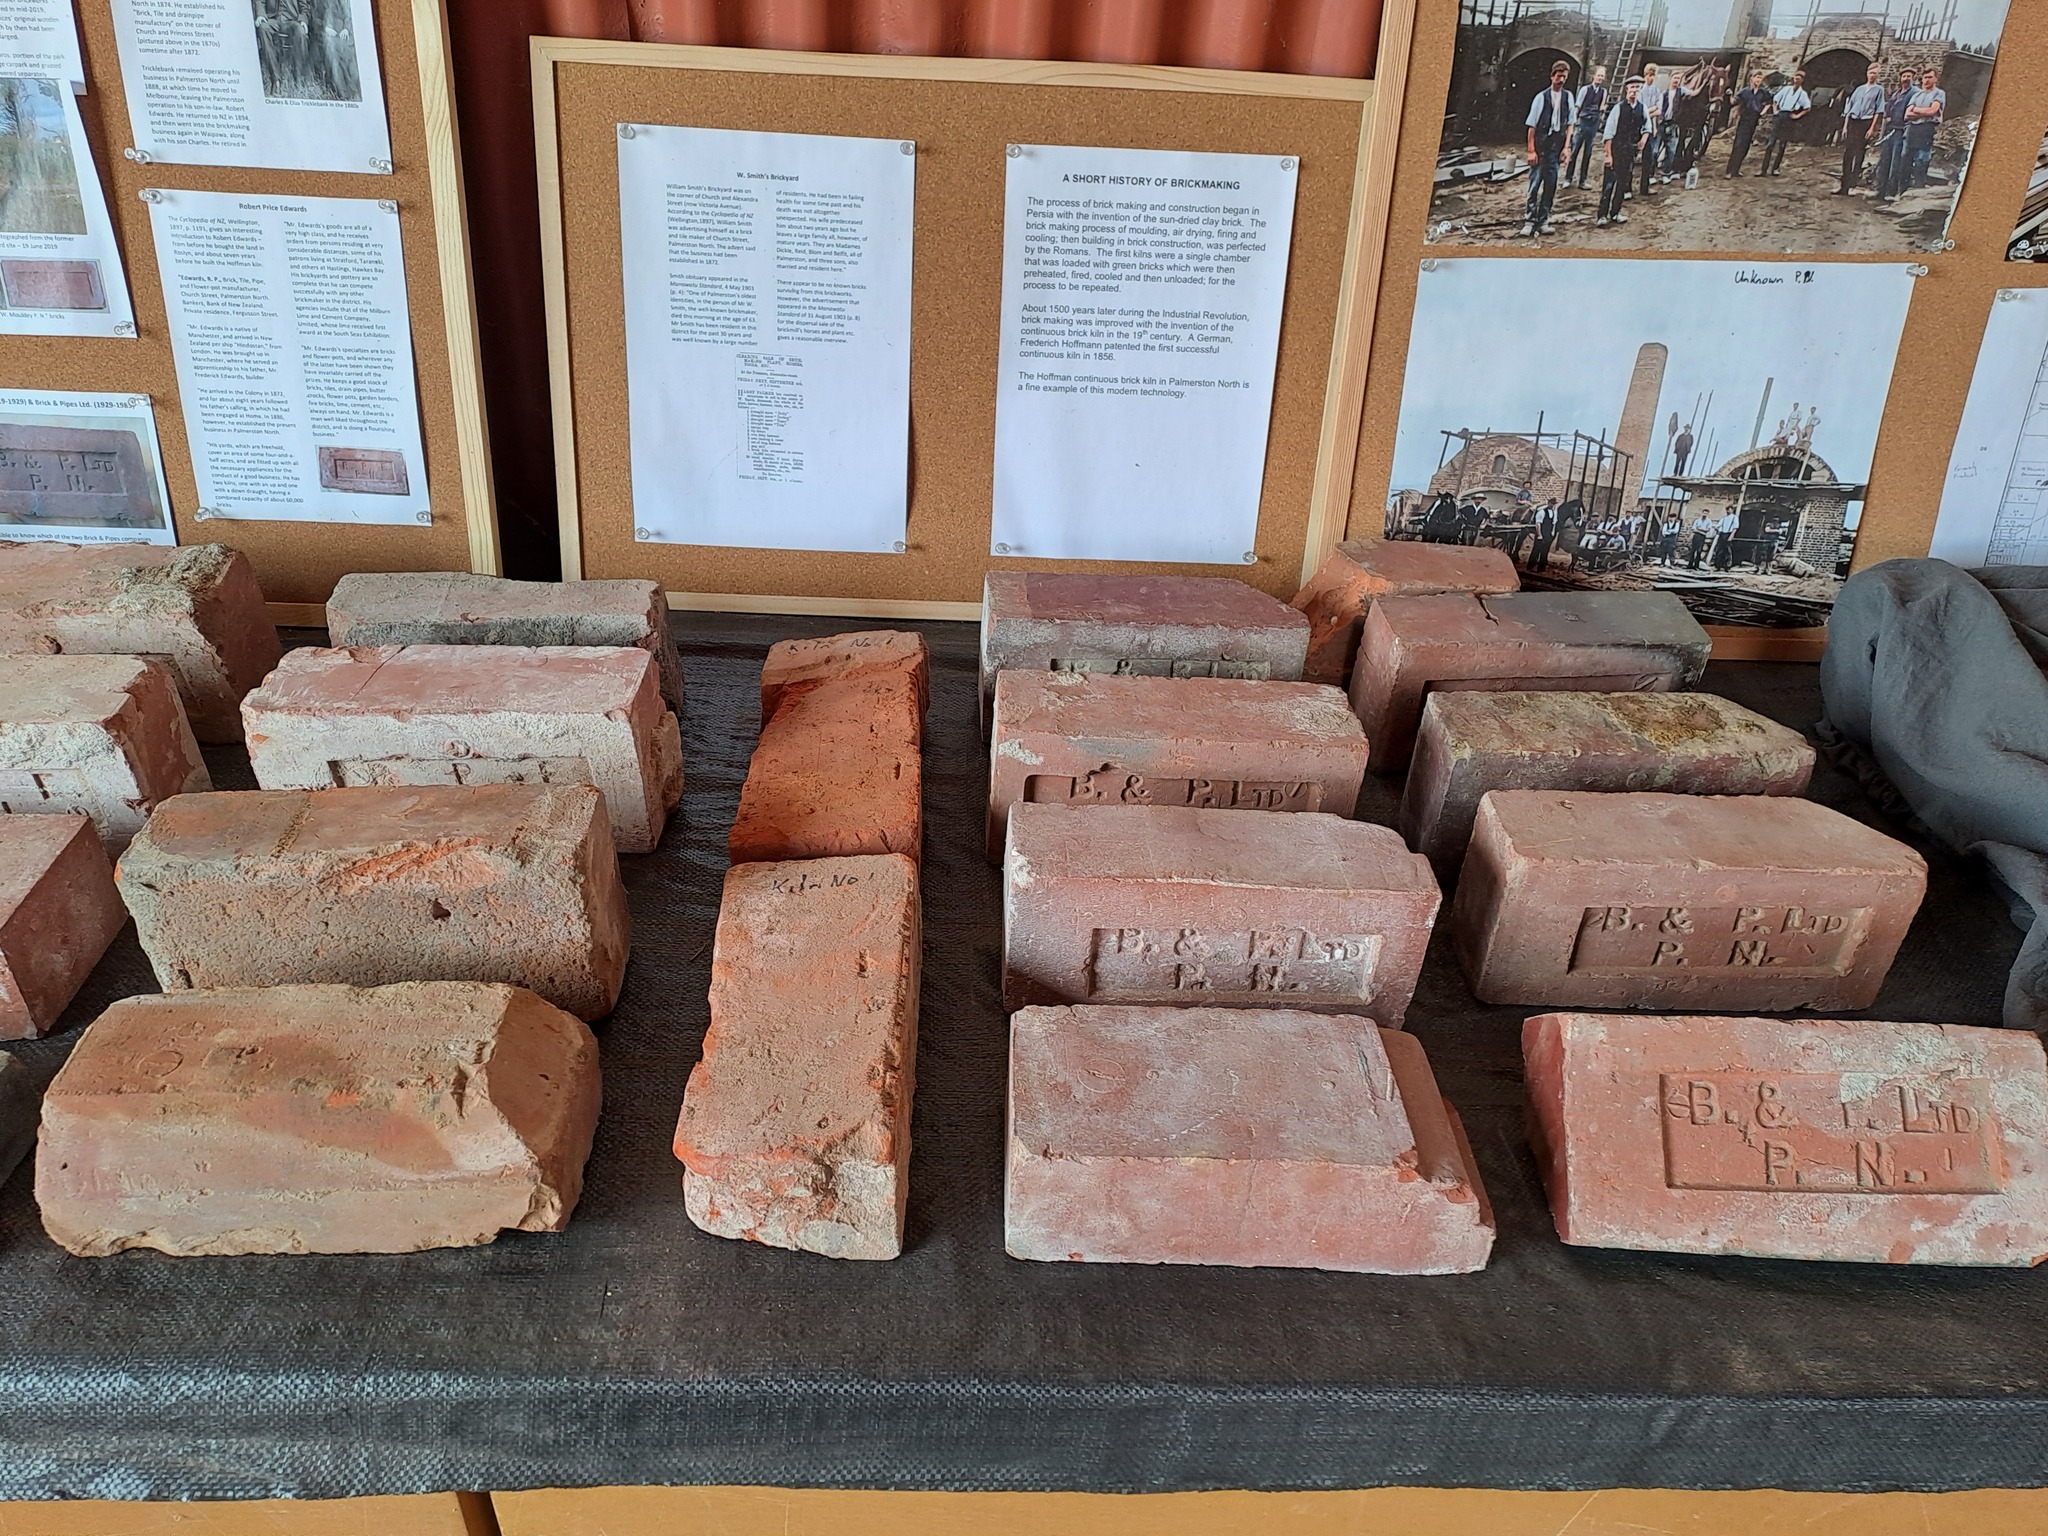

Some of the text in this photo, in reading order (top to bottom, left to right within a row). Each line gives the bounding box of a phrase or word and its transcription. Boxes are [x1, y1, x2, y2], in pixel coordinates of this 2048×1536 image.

[135, 27, 156, 35] Church
[141, 64, 175, 72] Tricklebank
[142, 73, 168, 81] business
[175, 75, 208, 83] Palmerston
[747, 172, 769, 180] Smith's
[770, 173, 798, 182] Brickyard
[1062, 173, 1240, 190] A SHORT HISTORY OF BRICKMAKING
[707, 185, 732, 193] Brickyard
[238, 202, 307, 212] Robert Price Edwards
[1027, 196, 1259, 216] The process of brick making and construction began in
[1026, 208, 1266, 227] Persia with the invention of the sun-dried clay brick. The
[1025, 220, 1256, 240] brick making process of moulding, air drying, firing and
[1025, 233, 1266, 252] cooling; then building in brick construction, was perfected
[1734, 270, 1784, 284] Unknown
[1018, 370, 1249, 388] The Hoffman continuous brick kiln in Palmerston North is
[1025, 382, 1040, 391] fine
[1042, 384, 1077, 394] example
[1079, 384, 1088, 393] of
[1089, 385, 1104, 394] this
[1106, 386, 1138, 395] modern
[1140, 388, 1186, 399] technology.
[1121, 774, 1150, 804] &
[1602, 905, 1647, 934] B.
[1659, 906, 1696, 935] &
[1732, 906, 1774, 935] P.
[1173, 927, 1211, 957] &
[1650, 939, 1788, 967] P. N.
[1688, 1080, 1739, 1126] B.
[1755, 1080, 1800, 1129] &
[1763, 1139, 1928, 1187] P. N.
